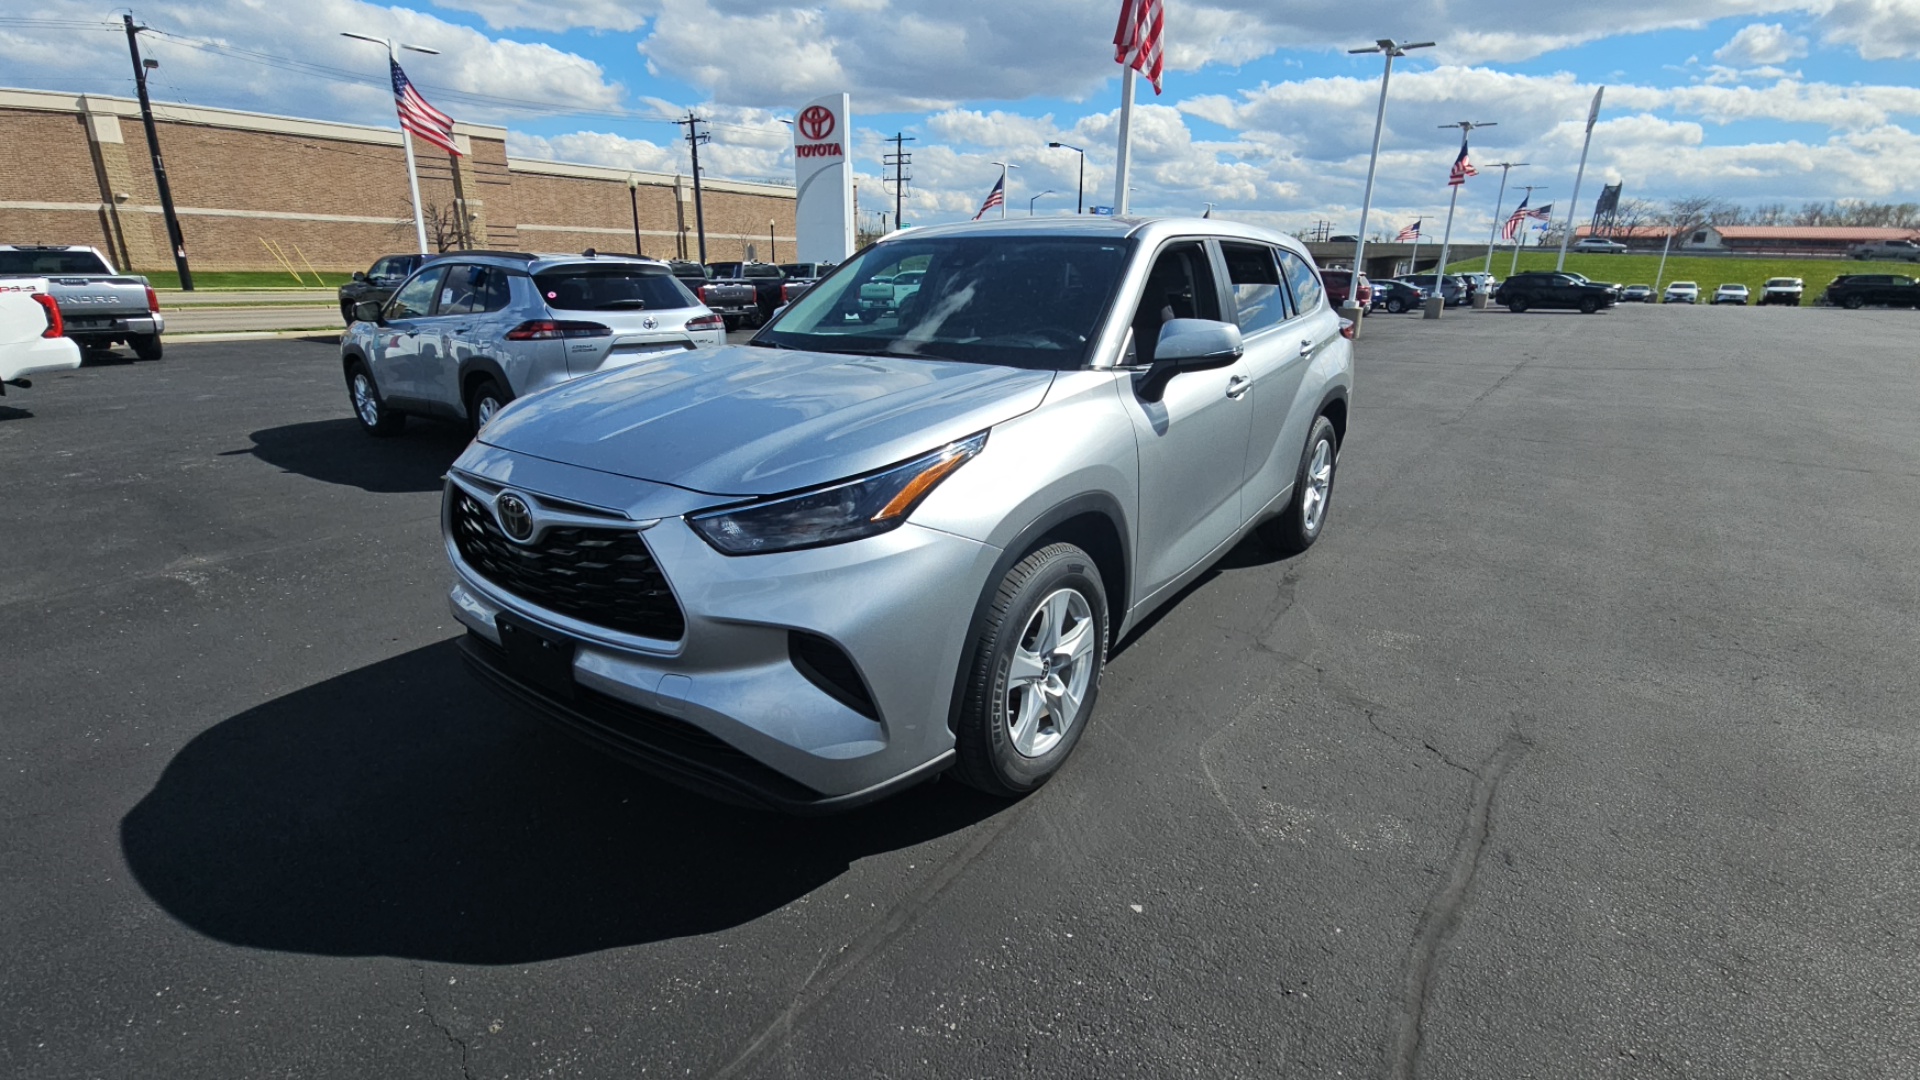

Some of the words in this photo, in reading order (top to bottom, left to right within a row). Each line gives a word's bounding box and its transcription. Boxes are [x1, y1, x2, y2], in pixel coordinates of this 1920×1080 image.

[795, 143, 842, 158] TOYOTA
[57, 295, 121, 304] UNDRA
[992, 657, 1008, 745] MICHELIN
